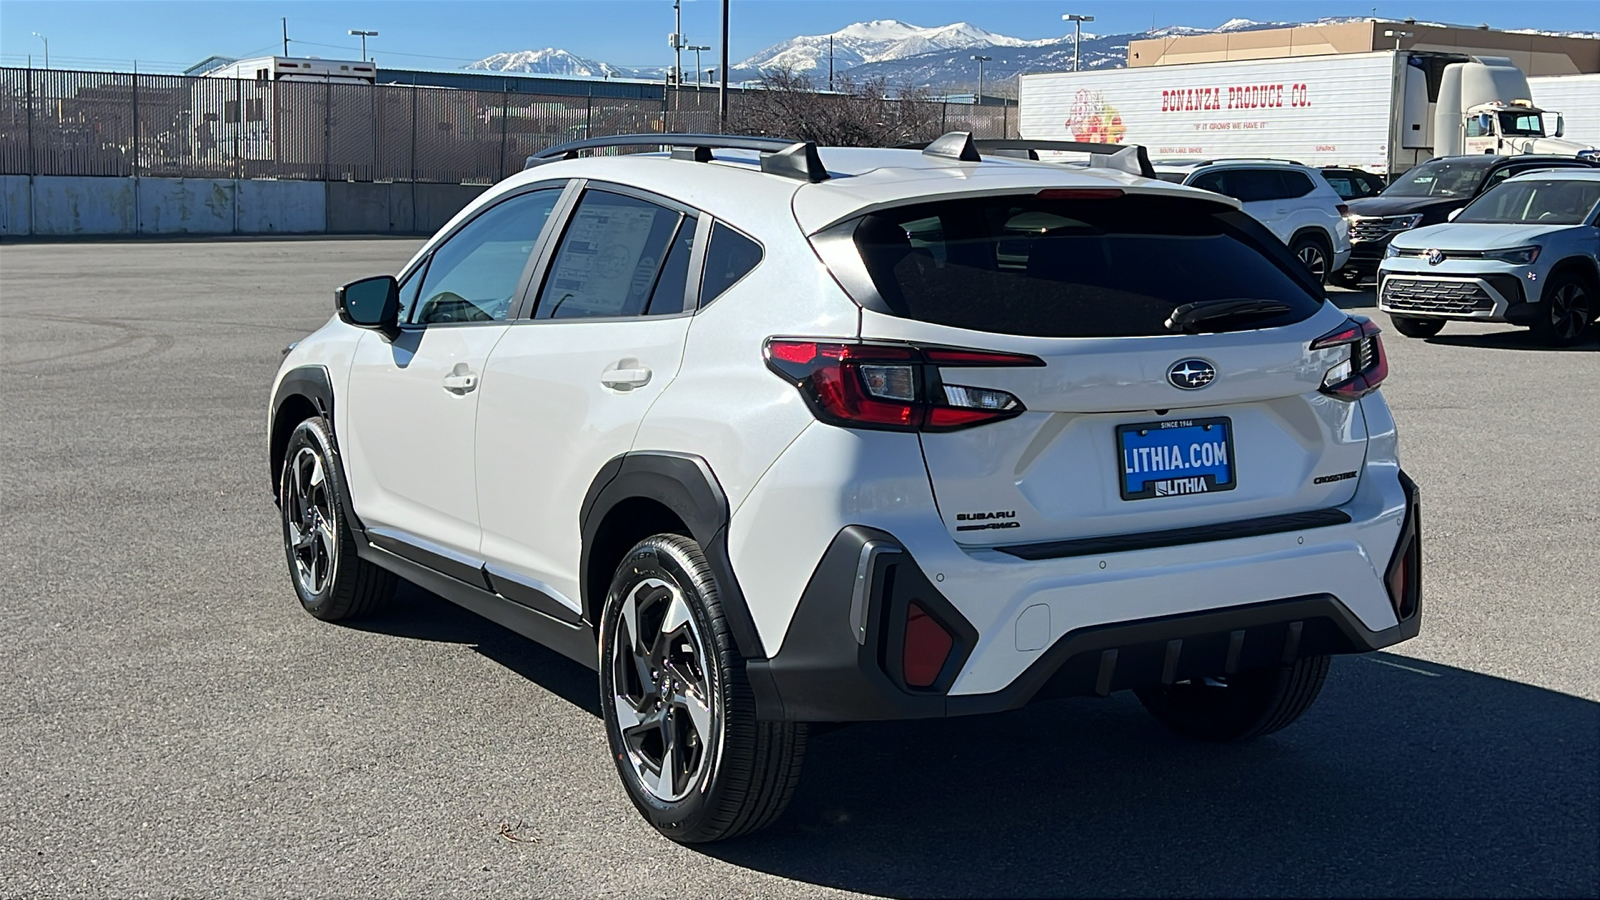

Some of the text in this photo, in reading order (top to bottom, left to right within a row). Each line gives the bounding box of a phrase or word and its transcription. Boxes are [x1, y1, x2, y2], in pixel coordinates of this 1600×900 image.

[1162, 83, 1311, 112] BONANZA PRODUCE CO.
[1161, 421, 1178, 429] SINCE
[1124, 441, 1228, 474] LITHIA.COM
[1313, 470, 1358, 484] CROSSTREK
[1167, 477, 1208, 494] LITHIA
[956, 510, 1016, 521] SUBARU
